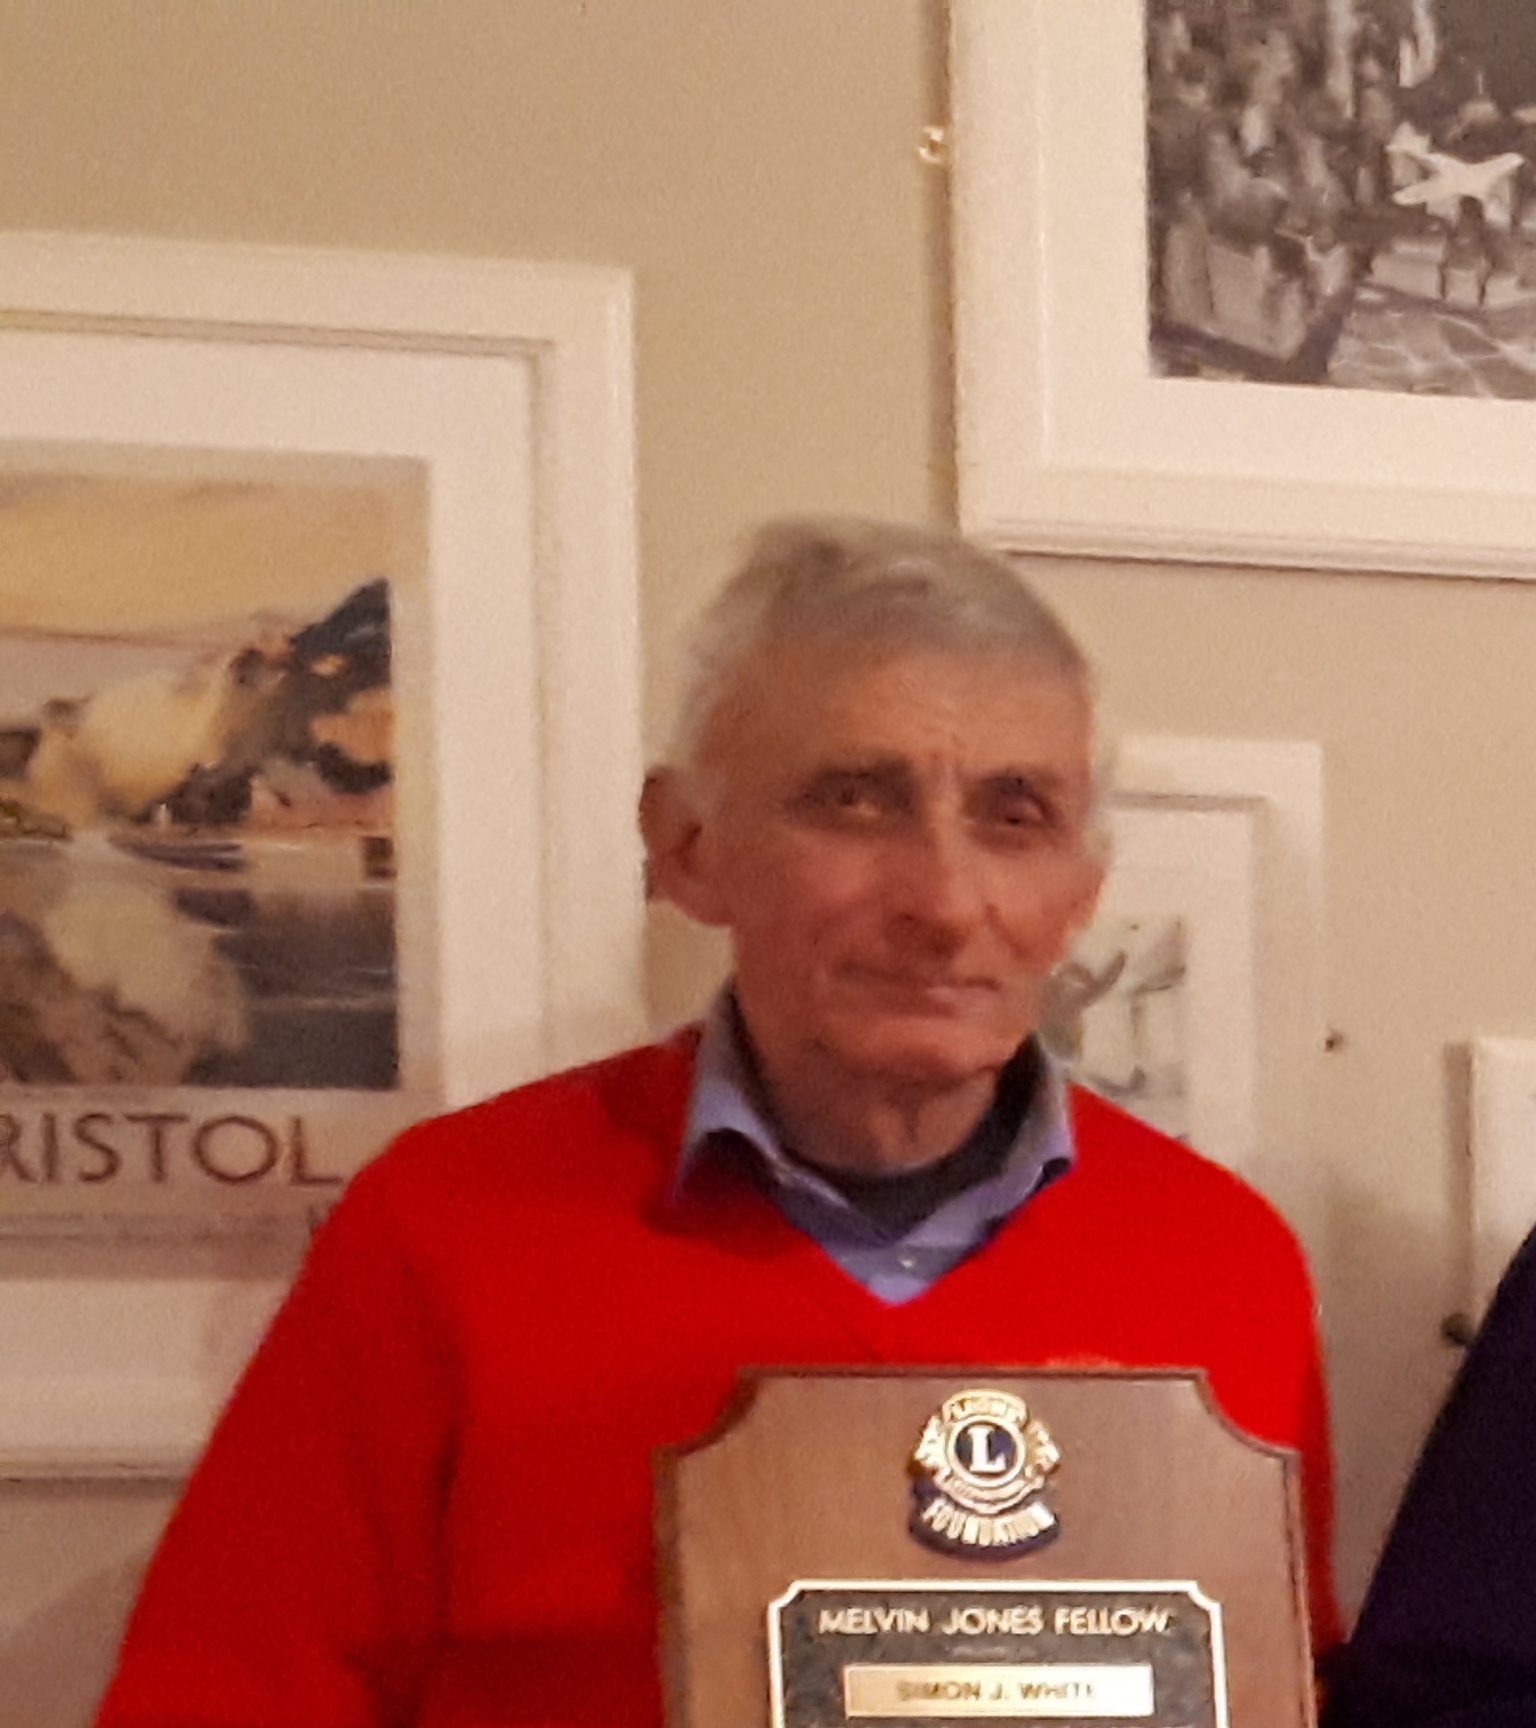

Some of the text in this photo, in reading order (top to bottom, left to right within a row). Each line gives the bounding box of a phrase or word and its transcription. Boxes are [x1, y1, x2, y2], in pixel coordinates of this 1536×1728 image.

[967, 1427, 1006, 1472] L
[818, 1605, 1172, 1635] MELVIN JONES FELLOW
[896, 1680, 982, 1701] SIMON
